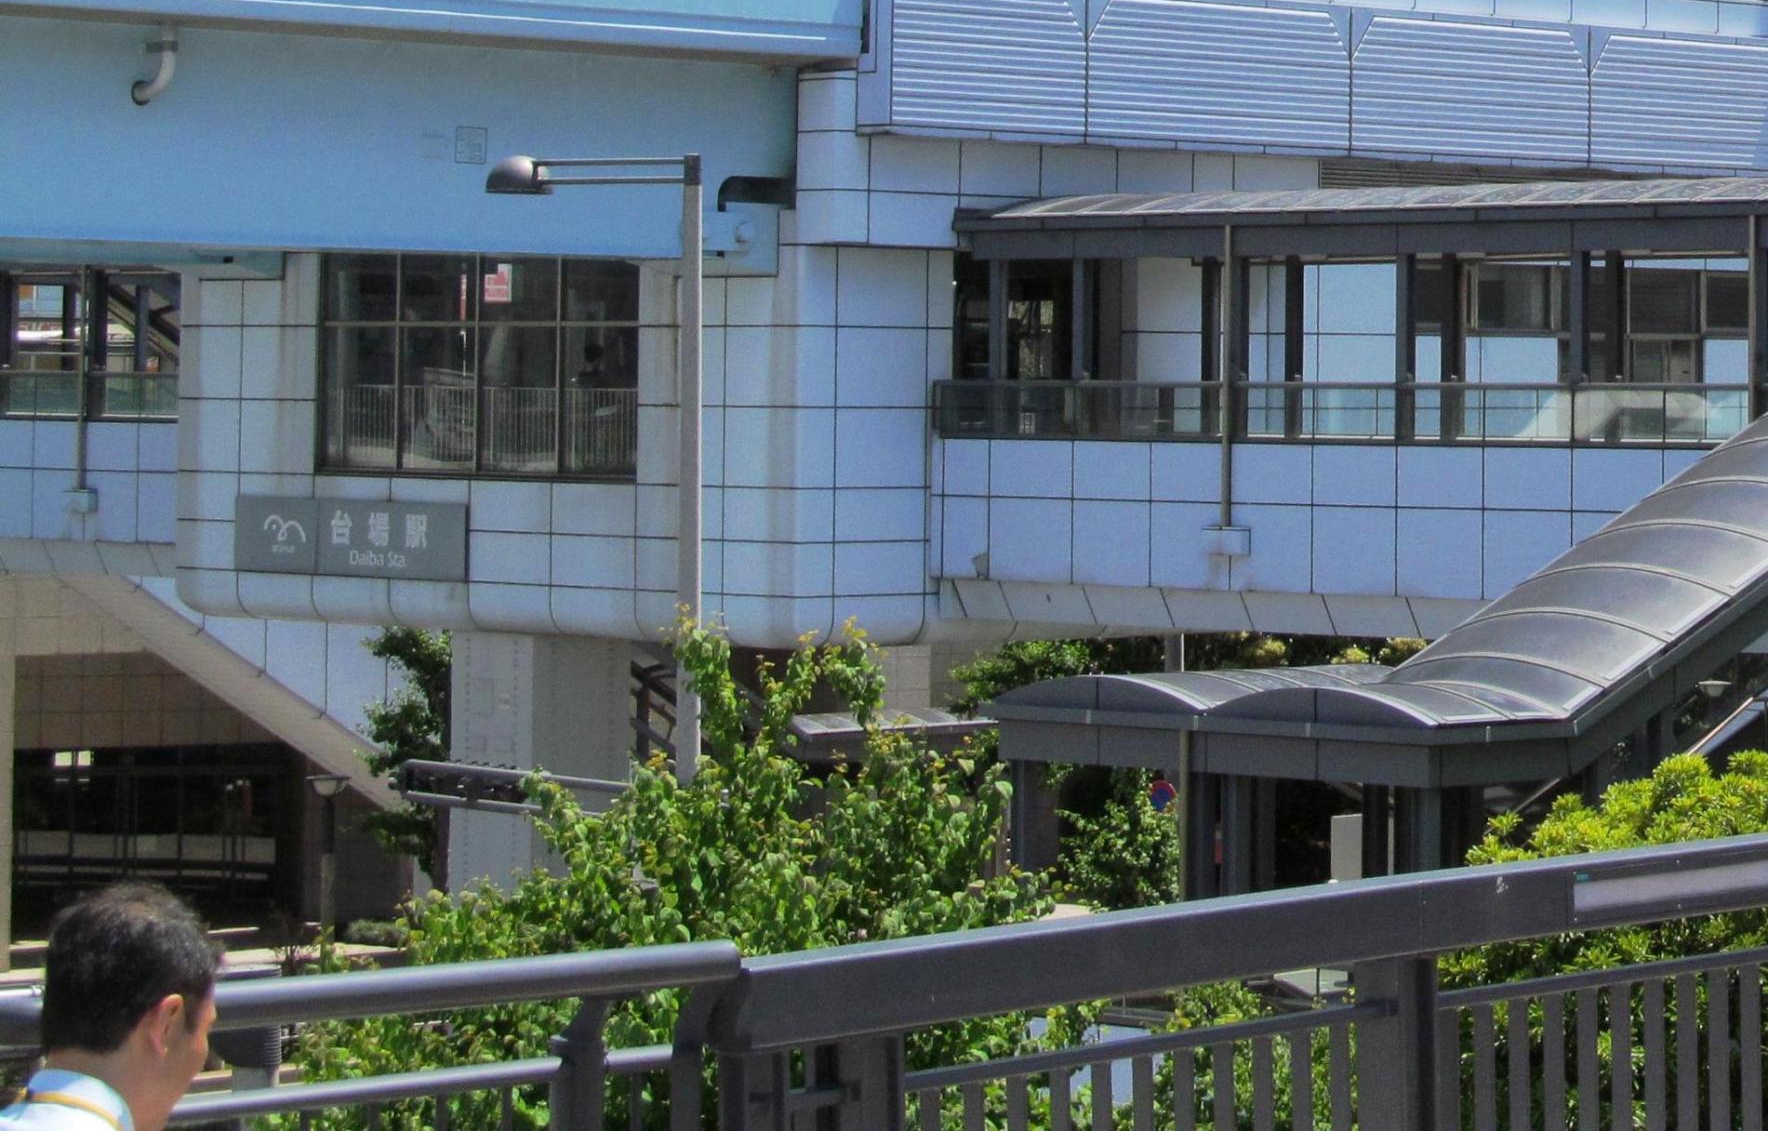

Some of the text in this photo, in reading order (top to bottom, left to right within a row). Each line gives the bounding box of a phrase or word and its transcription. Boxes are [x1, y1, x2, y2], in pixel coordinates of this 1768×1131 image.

[330, 509, 428, 548] 台場駅
[349, 549, 384, 567] Daiba
